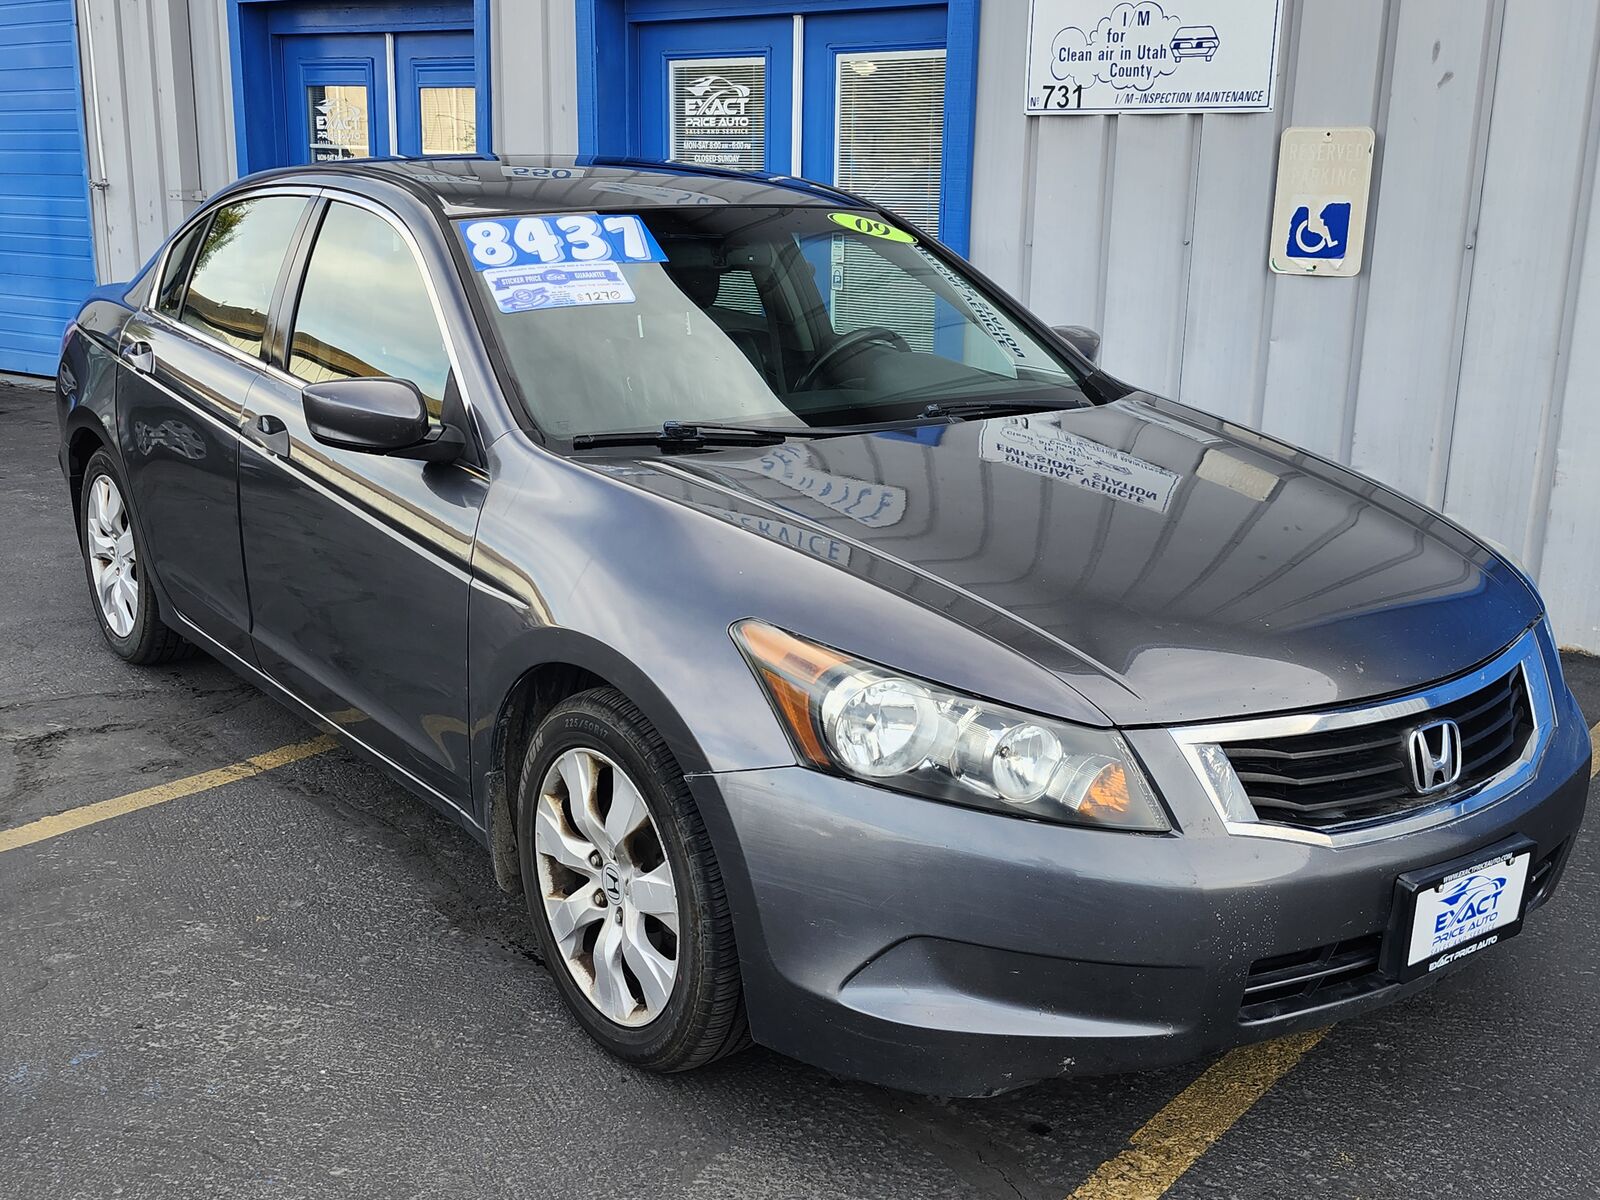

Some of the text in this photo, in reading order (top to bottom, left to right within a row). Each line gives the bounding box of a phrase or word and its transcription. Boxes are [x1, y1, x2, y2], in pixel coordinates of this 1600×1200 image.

[1122, 11, 1150, 27] I/M
[1107, 28, 1125, 43] for
[1058, 46, 1167, 62] Clean air in Utah
[1109, 63, 1152, 79] County
[1042, 85, 1082, 109] 731
[1196, 90, 1264, 103] MAINTENANCE
[685, 98, 750, 115] EXACT
[685, 116, 749, 127] PRICE AUTO
[466, 216, 651, 267] 8437
[501, 276, 525, 286] STICKER
[525, 275, 543, 284] PRICE
[574, 271, 606, 280] GUARANTEE
[1434, 889, 1503, 934] EXACT
[1432, 912, 1499, 946] PRICE AUTO
[1429, 935, 1498, 972] EXACT PRICE AUTO
